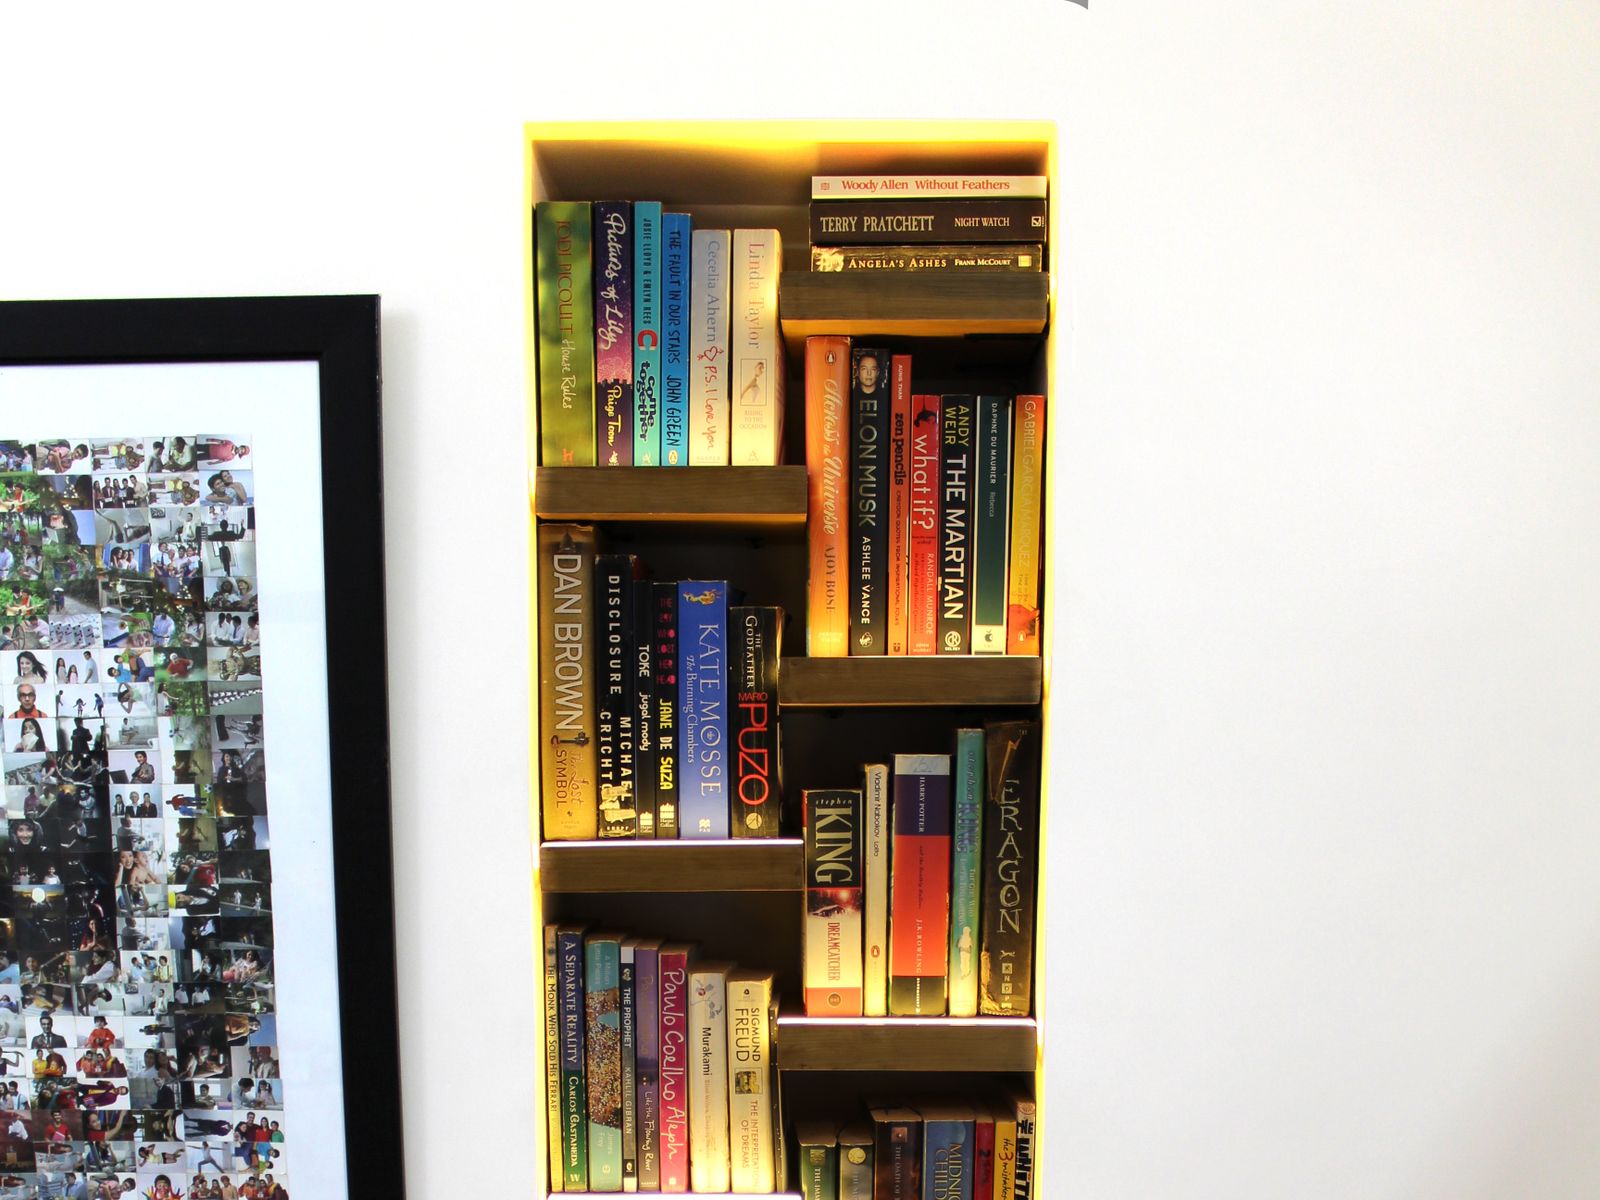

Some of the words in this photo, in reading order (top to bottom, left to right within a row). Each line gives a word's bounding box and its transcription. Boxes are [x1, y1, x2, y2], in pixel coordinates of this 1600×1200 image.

[841, 180, 878, 193] Woody
[880, 179, 909, 190] Allen
[915, 179, 959, 190] Without
[961, 179, 1010, 190] Feathers
[556, 220, 573, 257] JODI
[669, 229, 681, 250] THE
[820, 216, 858, 233] TERRY
[863, 215, 934, 232] PRATCHETT
[954, 217, 980, 228] NIGHT
[981, 217, 1010, 228] WATCH
[605, 212, 627, 281] Pictures
[707, 241, 721, 290] Cecelia
[668, 254, 681, 287] FAULT
[748, 242, 766, 291] Linda
[558, 263, 573, 335] PICOULT
[600, 284, 617, 300] of
[668, 290, 681, 300] IN
[597, 303, 624, 350] Lily
[668, 303, 681, 326] OUR
[706, 293, 720, 343] Ahern
[744, 296, 766, 350] Taylor
[561, 338, 576, 373] House
[667, 329, 681, 365] STARS
[561, 376, 577, 410] Rules
[604, 385, 622, 417] Paige
[636, 360, 651, 441] together
[646, 376, 657, 428] come
[665, 374, 682, 404] JOHN
[607, 414, 621, 447] Toon
[665, 407, 682, 447] GREEN
[857, 399, 878, 459] ELON
[894, 412, 905, 437] zen
[944, 407, 957, 445] WEIR
[957, 405, 969, 447] ANDY
[990, 403, 998, 434] DAPHNE
[990, 436, 997, 448] DU
[892, 438, 907, 486] pencils
[914, 434, 937, 495] what
[945, 454, 967, 501] THE
[989, 450, 997, 484] MAURIER
[858, 465, 877, 527] MUSK
[913, 498, 936, 530] if?
[988, 491, 997, 517] Rebecca
[824, 544, 838, 576] AJOY
[861, 536, 872, 581] ASHLEE
[926, 553, 935, 594] RANDALL
[943, 508, 966, 619] MARTIAN
[552, 553, 582, 614] DAN
[825, 580, 837, 614] BOSE
[860, 585, 871, 625] VANCE
[925, 595, 934, 636] MUNROE
[608, 575, 622, 696] DISCLOSURE
[745, 615, 757, 688] GODFATHER
[754, 634, 762, 649] THE
[552, 622, 584, 731] BROWN
[638, 644, 650, 678] TOKE
[686, 655, 696, 671] The
[698, 623, 720, 693] KATE
[638, 692, 650, 719] jugal
[682, 672, 698, 714] Burning
[737, 691, 769, 701] MARIO
[659, 698, 673, 729] JANE
[639, 721, 651, 751] mody
[659, 736, 673, 750] DE
[686, 714, 698, 764] Chambers
[699, 700, 722, 797] MOSSE
[738, 703, 769, 806] PUZO
[619, 716, 632, 802] MICHAEL
[660, 756, 674, 790] SUZA
[554, 749, 567, 809] SYMBOL
[873, 771, 883, 803] Vladimir
[918, 776, 926, 801] HARRY
[873, 804, 882, 838] Nabokov
[918, 803, 926, 833] POTTER
[957, 801, 980, 854] KING
[815, 806, 853, 884] KING
[565, 941, 577, 950] A
[827, 922, 841, 981] DREAMCATCHER
[565, 954, 578, 1011] SEPARATE
[623, 988, 632, 1007] THE
[663, 968, 685, 1026] Paulo
[566, 1014, 578, 1063] REALITY
[623, 1008, 632, 1048] PROPHET
[735, 1008, 750, 1062] FREUD
[750, 1007, 761, 1062] SIGMUND
[661, 1030, 685, 1101] Coelho
[701, 1027, 712, 1076] Murakami
[568, 1076, 580, 1112] CARLOS
[624, 1066, 632, 1099] KAHLIL
[625, 1103, 633, 1134] GIBRAN
[661, 1105, 685, 1161] Aleph
[741, 1119, 749, 1133] OF
[569, 1113, 580, 1167] CASTANEDA
[741, 1134, 749, 1169] DREAMS
